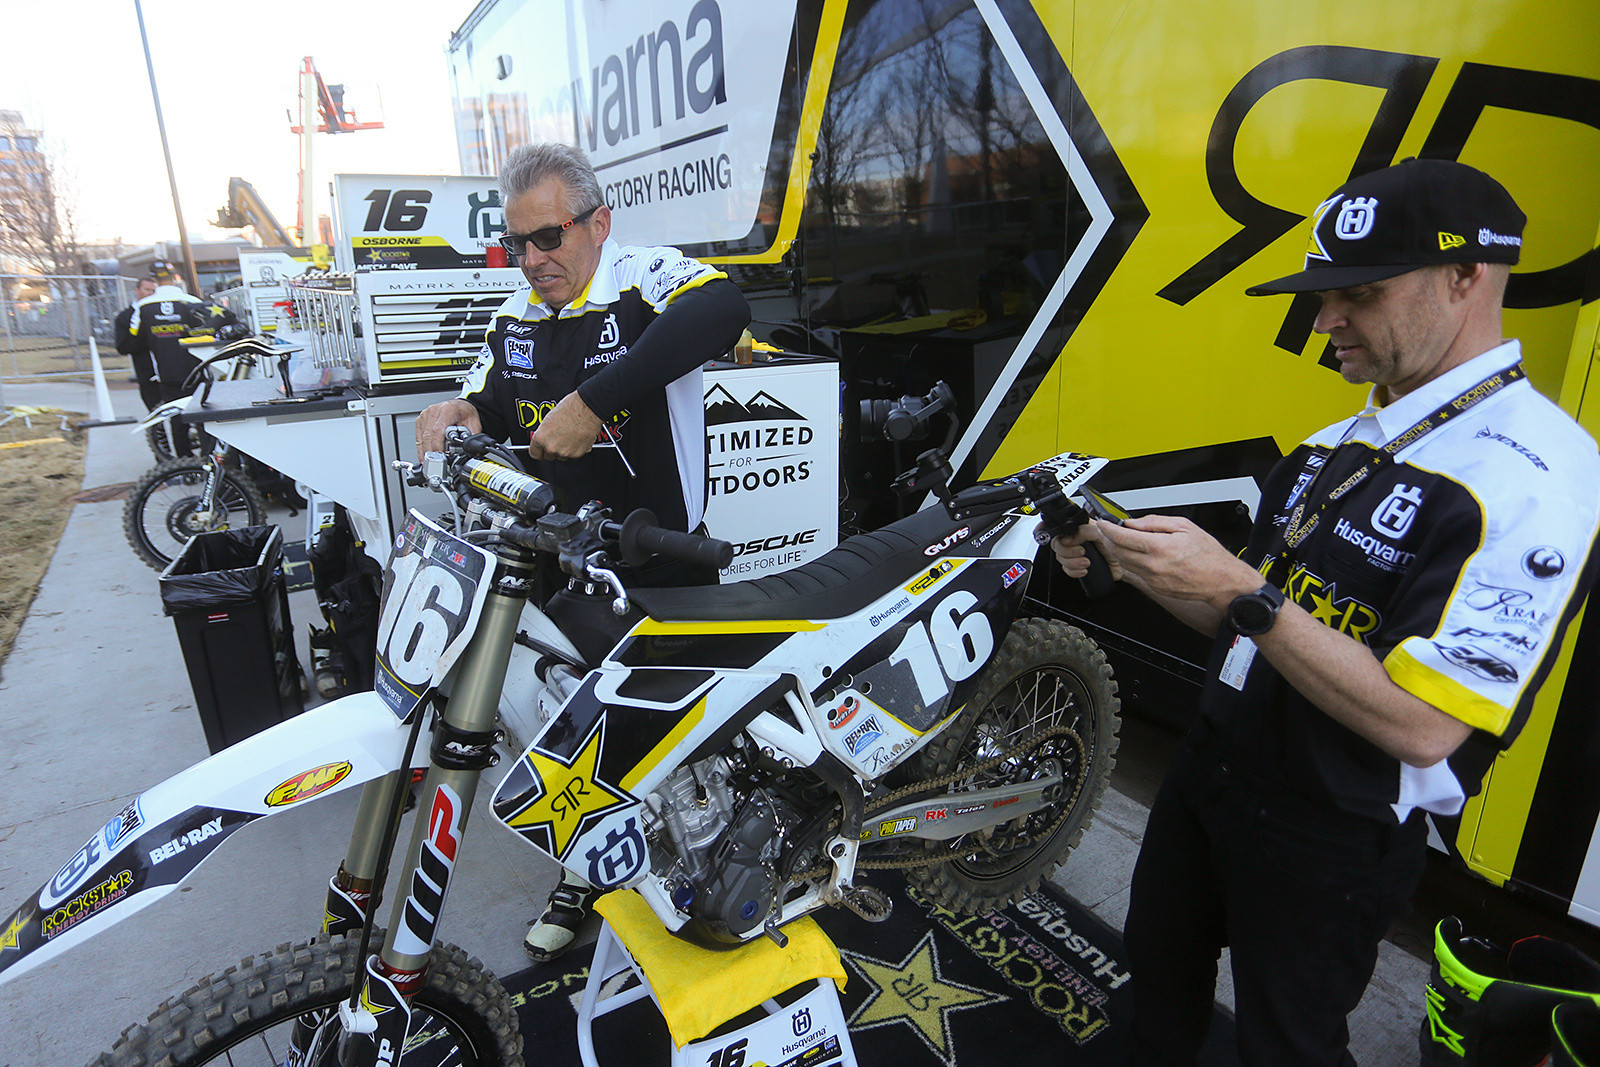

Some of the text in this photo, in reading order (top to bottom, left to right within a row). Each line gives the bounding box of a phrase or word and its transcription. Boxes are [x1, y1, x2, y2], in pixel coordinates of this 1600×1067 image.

[571, 0, 727, 152] varna
[606, 153, 732, 211] CTORY RACING
[363, 189, 433, 232] 16
[362, 237, 422, 246] OSBORNE
[389, 280, 526, 290] MATRIX CONCE
[708, 427, 814, 455] TIMIZED
[729, 457, 752, 468] FOR
[1059, 461, 1091, 487] NLOP
[708, 461, 811, 496] TDOORS
[732, 529, 820, 557] OSCHE
[924, 526, 970, 557] GUTS
[1333, 517, 1417, 565] Husqvarn
[754, 558, 775, 570] FOR
[777, 551, 801, 565] LIFE
[1001, 562, 1027, 590] AMA
[378, 550, 463, 686] 16
[877, 596, 910, 622] Husqvarna
[888, 590, 995, 708] 16
[269, 760, 349, 807] FMF
[881, 818, 916, 836] PROTAPER
[925, 808, 948, 821] RK
[49, 888, 125, 937] ENERGY DRINK
[1008, 898, 1132, 990] Husqva
[908, 887, 1108, 1040] ROCKST
[781, 1027, 827, 1056] Husqvarna
